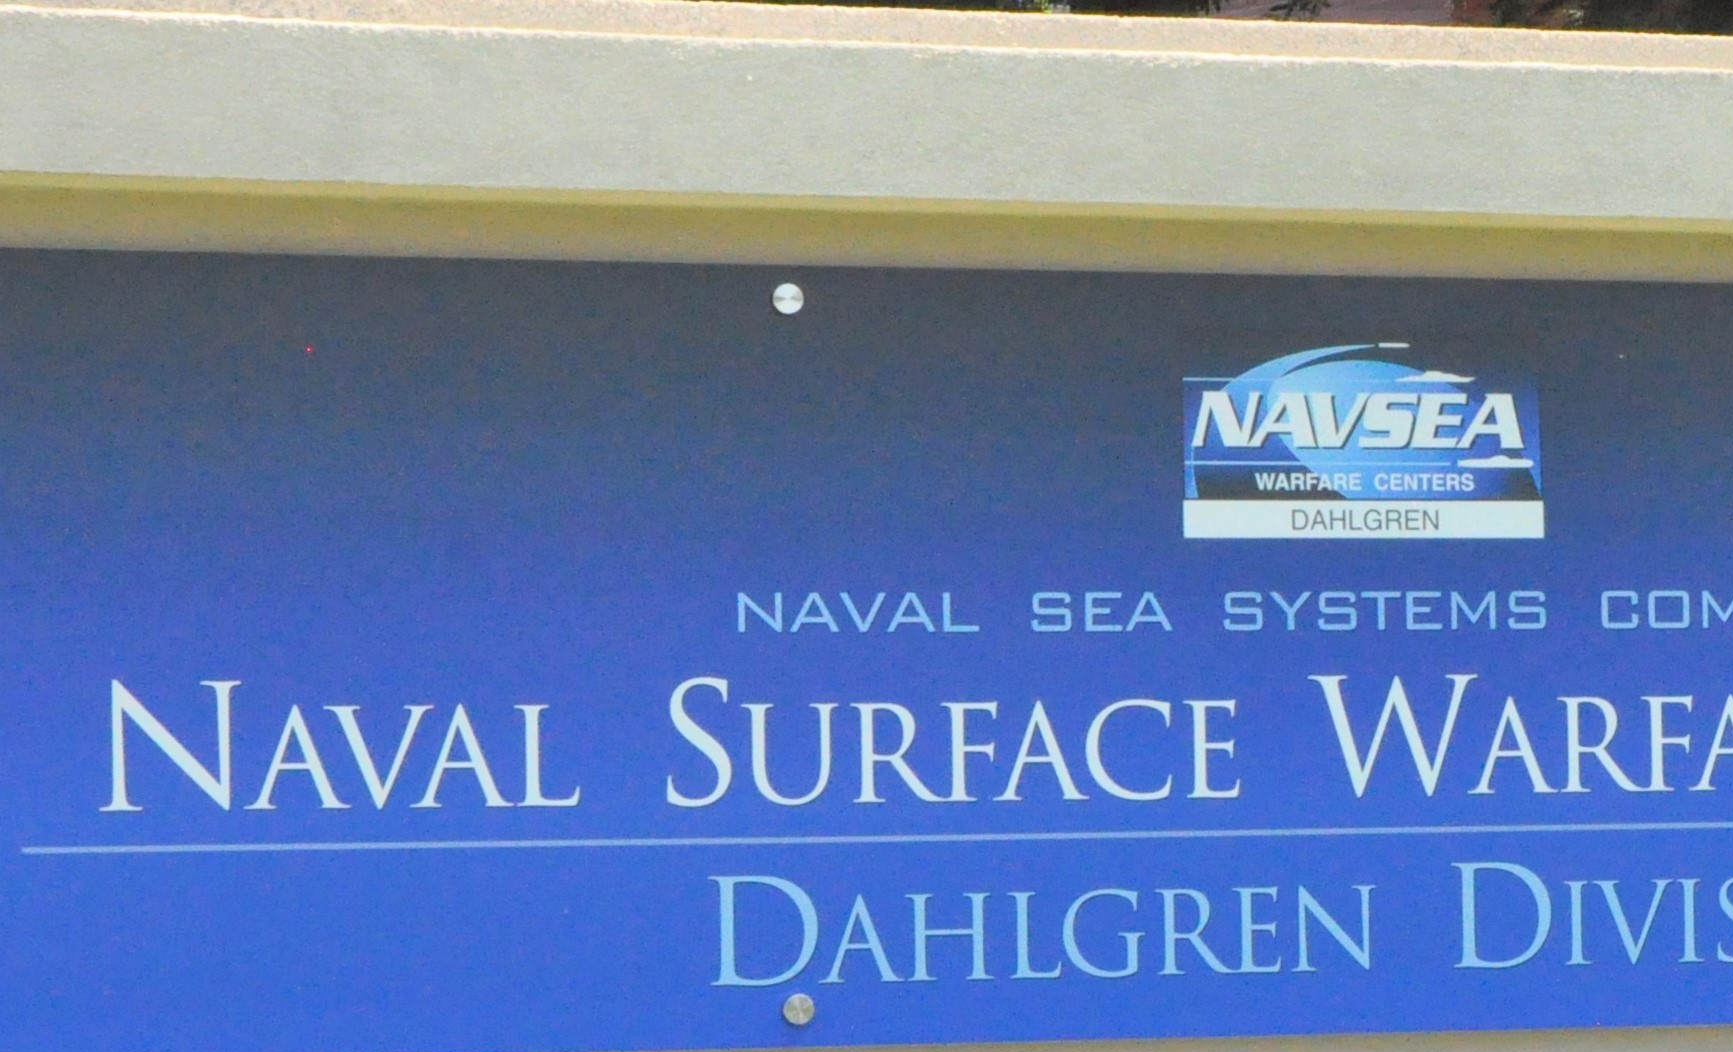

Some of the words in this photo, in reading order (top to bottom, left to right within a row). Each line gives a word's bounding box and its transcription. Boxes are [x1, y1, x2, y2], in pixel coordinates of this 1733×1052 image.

[1191, 391, 1525, 450] NAVSEA
[1254, 472, 1363, 492] WARFARE
[1374, 472, 1475, 492] CENTERS
[1291, 509, 1440, 531] DAHLGREN
[735, 591, 980, 633] NAVAL
[1030, 590, 1173, 633] SEA
[1221, 589, 1549, 633] SYSTEMS
[98, 678, 582, 813] NAVAL
[664, 676, 1243, 808] SURFACE
[708, 874, 1376, 987] DAHLGREN
